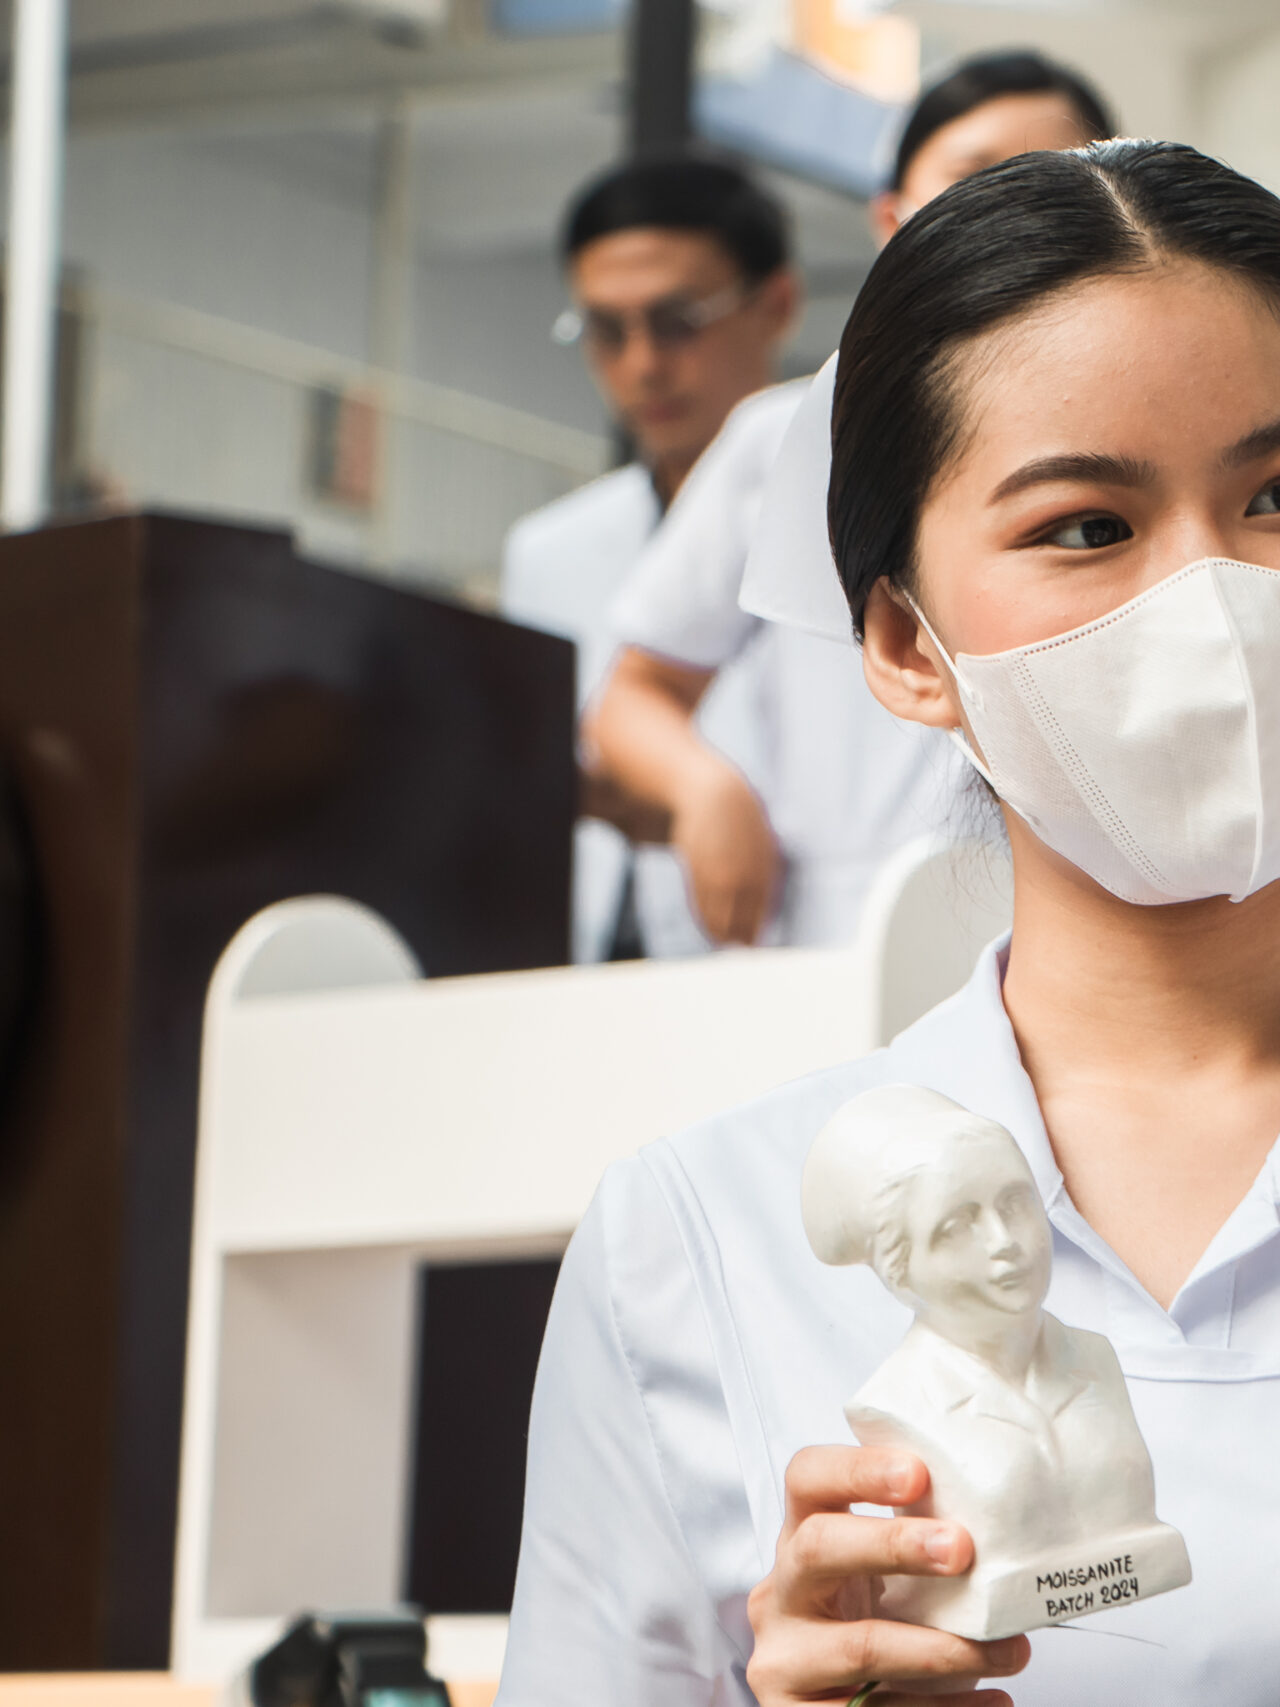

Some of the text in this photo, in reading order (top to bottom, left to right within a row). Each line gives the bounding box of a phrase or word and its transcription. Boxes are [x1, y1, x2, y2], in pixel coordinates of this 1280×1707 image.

[1037, 1554, 1134, 1592] MOISSANITE
[1046, 1577, 1139, 1617] BATCH 2024
